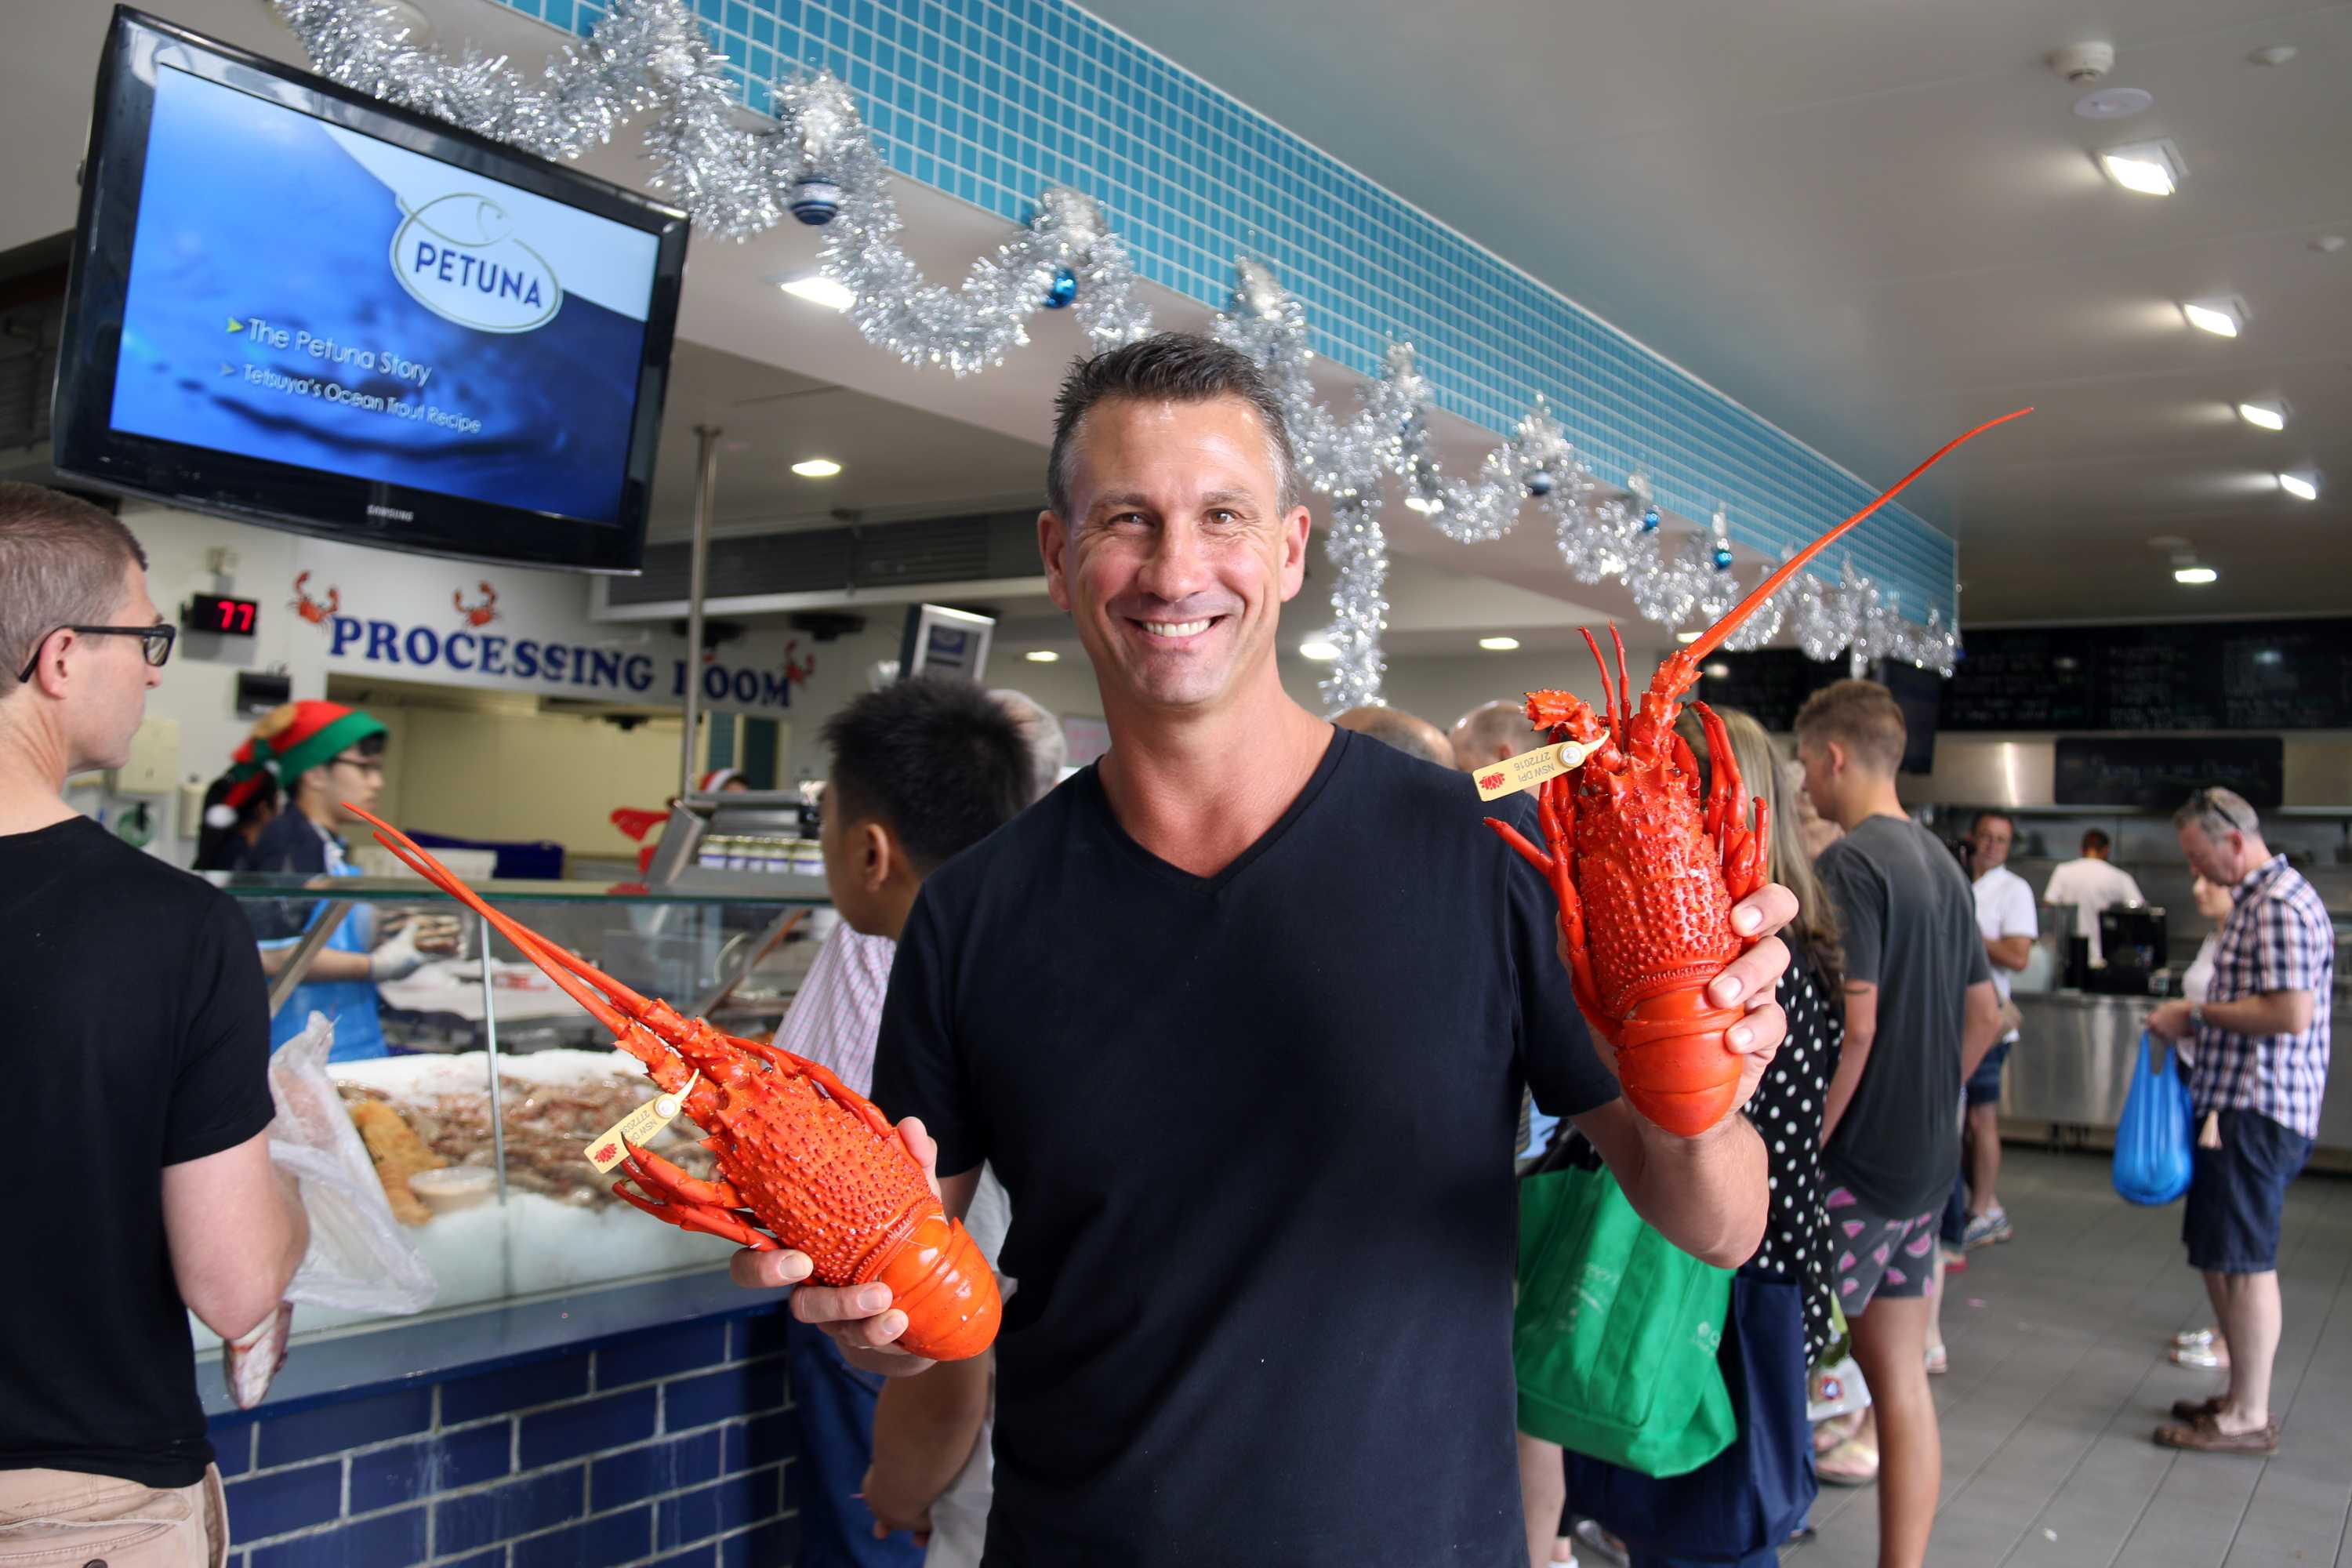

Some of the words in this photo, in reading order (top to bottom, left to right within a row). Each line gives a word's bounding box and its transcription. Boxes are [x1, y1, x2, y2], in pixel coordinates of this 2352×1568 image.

[415, 241, 543, 308] PETUNA
[248, 317, 290, 350] The
[294, 330, 376, 371] Petuna
[379, 350, 432, 387] Story
[324, 383, 385, 412] Ocean
[386, 396, 424, 421] Trout
[426, 405, 482, 434] Recipe
[330, 615, 654, 692] PROCESSING
